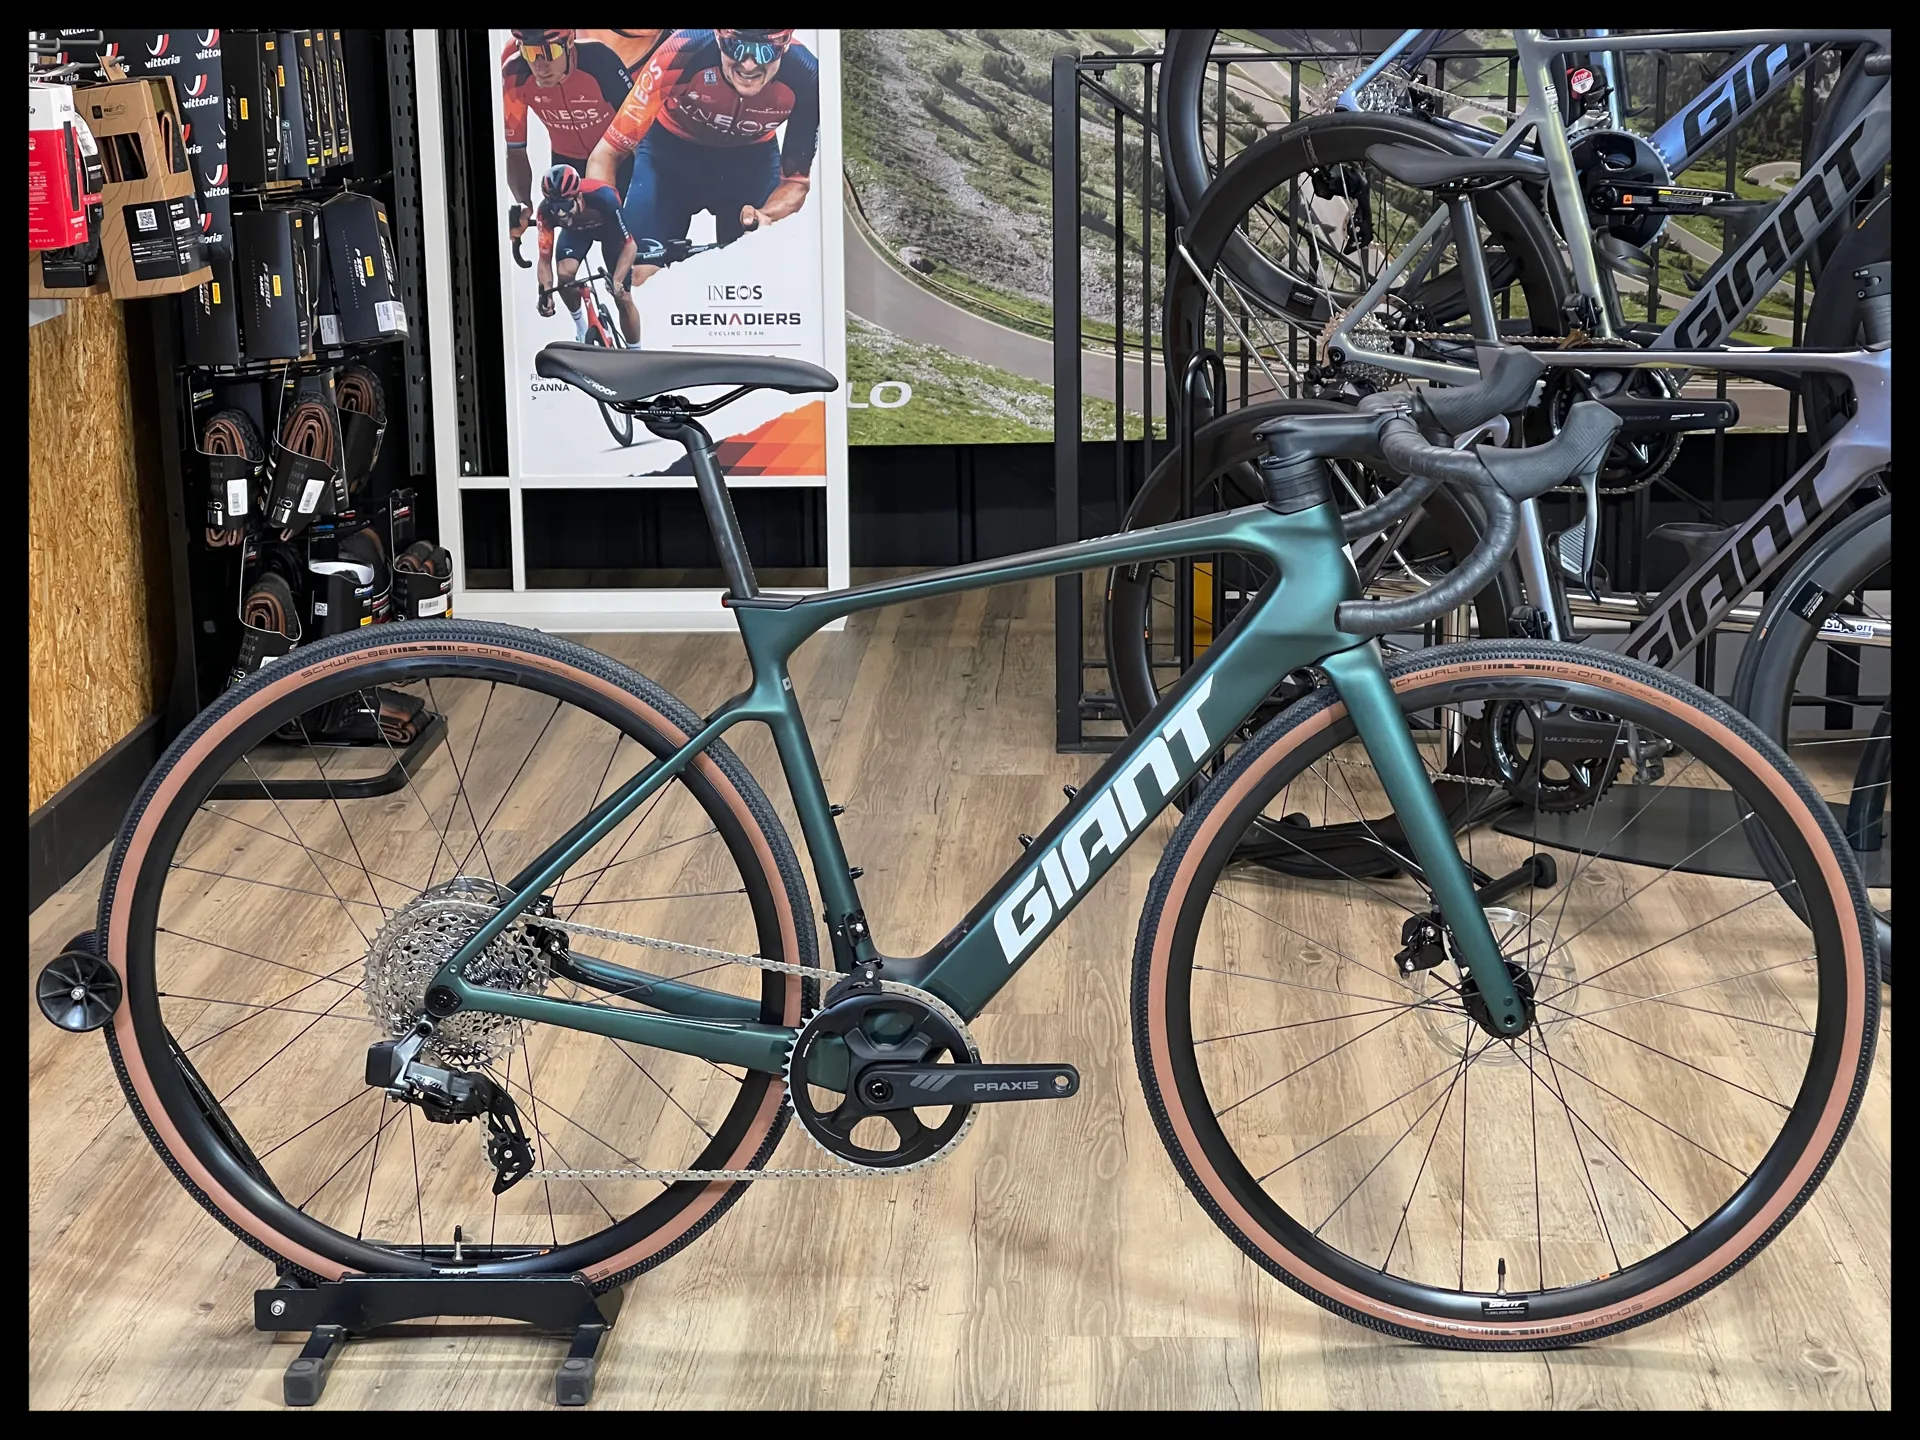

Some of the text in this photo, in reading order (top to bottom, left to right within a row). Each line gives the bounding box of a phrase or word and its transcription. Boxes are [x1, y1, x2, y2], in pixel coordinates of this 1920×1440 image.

[144, 54, 181, 69] vittoria
[1574, 72, 1589, 83] STOP
[623, 59, 663, 127] INEOS
[182, 95, 219, 109] vittoria
[541, 108, 599, 121] INEOS
[1674, 116, 1867, 348] GIANT
[708, 285, 763, 300] INEOS
[670, 312, 802, 326] GRENADIERS
[530, 383, 571, 392] GANNA
[847, 380, 912, 409] LO
[1626, 450, 1830, 669] GIANT
[301, 648, 389, 678] SCHWALBE
[457, 645, 512, 658] G-ONE
[1556, 666, 1613, 684] G-ONE
[1544, 735, 1603, 745] ULTEGRA
[993, 673, 1214, 964] GIANT
[973, 1081, 1039, 1092] PRAXIS
[1549, 1303, 1644, 1333] SCHWALBE
[1424, 1320, 1480, 1335] G-ONE
